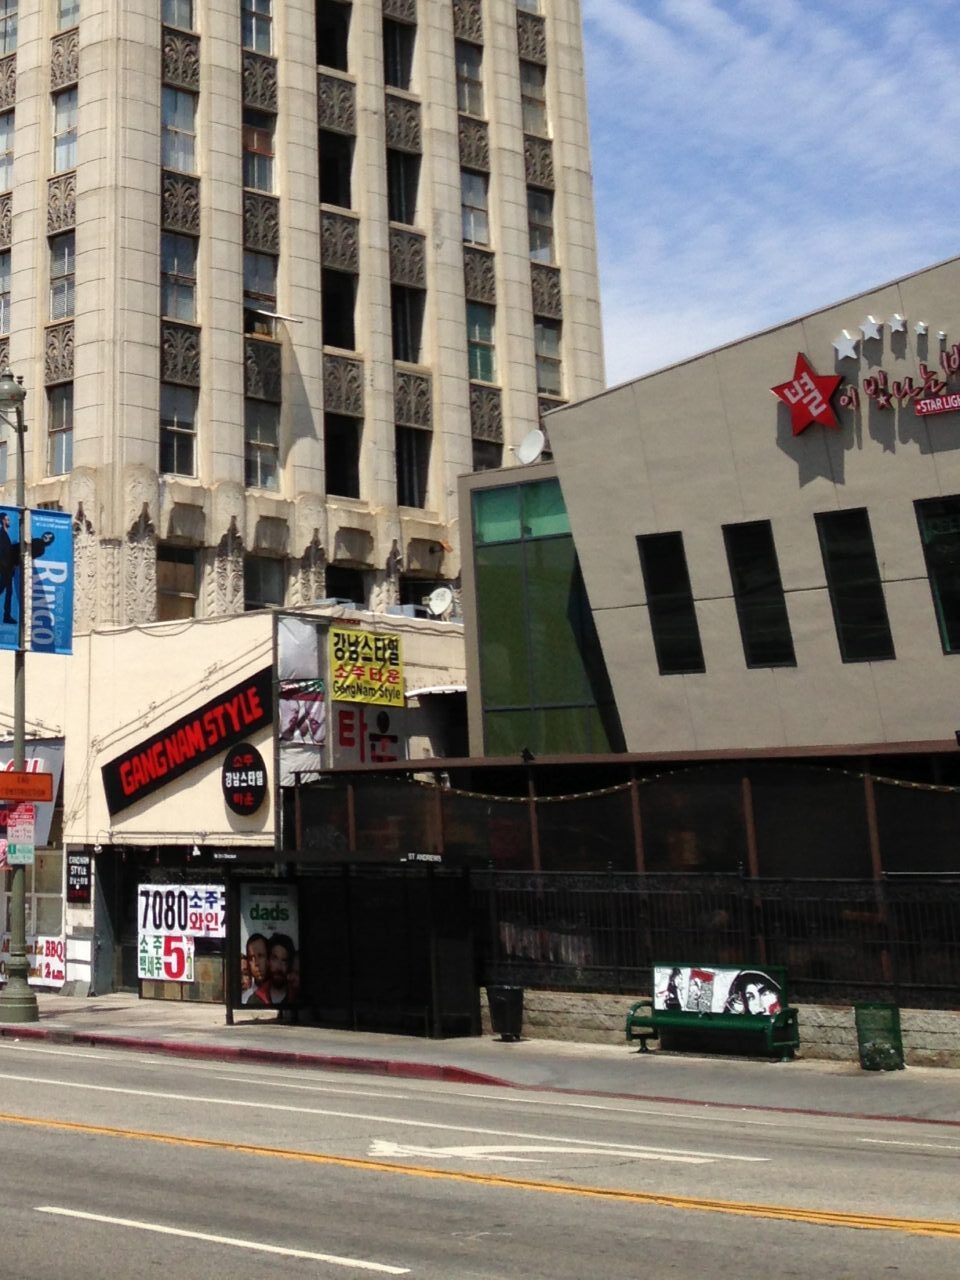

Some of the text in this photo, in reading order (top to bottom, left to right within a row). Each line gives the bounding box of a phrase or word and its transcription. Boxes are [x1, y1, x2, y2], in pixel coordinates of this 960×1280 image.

[920, 399, 943, 412] STAR
[32, 560, 67, 645] RINGO
[333, 632, 400, 666] 강남스타일
[334, 665, 400, 684] 소주타운
[378, 687, 401, 702] Style
[203, 686, 264, 746] STYLE
[225, 771, 264, 788] 강남스타일
[416, 854, 442, 862] ANDREWS
[70, 866, 87, 875] STYLE
[190, 891, 218, 909] 소주
[140, 890, 189, 931] 7080
[250, 903, 290, 921] dads
[190, 912, 219, 932] 와인
[163, 936, 185, 979] 5
[44, 962, 52, 978] 2
